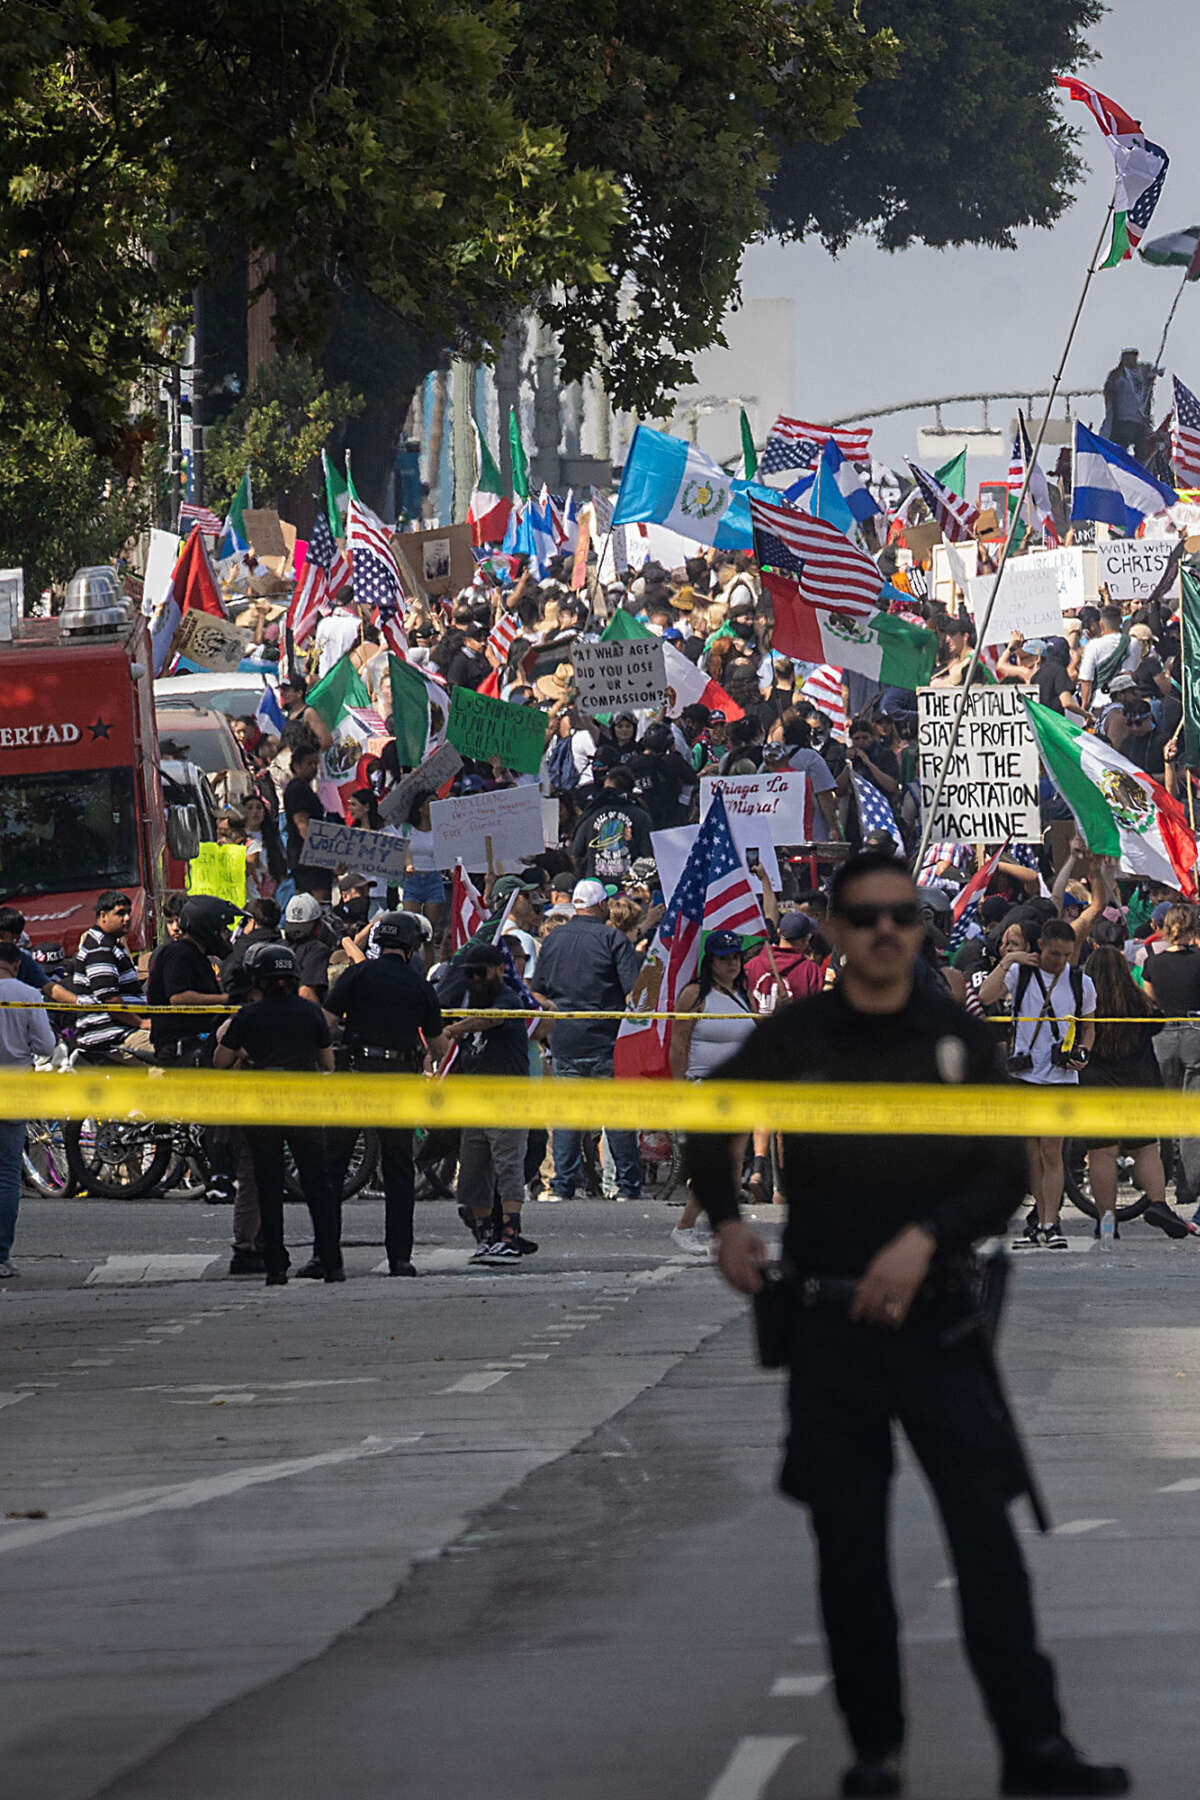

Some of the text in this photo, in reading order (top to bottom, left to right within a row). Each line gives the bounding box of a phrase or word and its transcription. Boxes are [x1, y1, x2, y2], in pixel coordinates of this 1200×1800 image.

[1144, 542, 1173, 554] with
[595, 645, 625, 659] WHAT
[630, 644, 650, 656] AGE
[577, 661, 654, 678] DID YOU LOSE
[607, 680, 622, 690] UR
[581, 689, 664, 707] COMPASSION?
[919, 692, 950, 717] THE
[977, 752, 1021, 778] THE
[766, 775, 790, 793] La
[921, 782, 1039, 808] DEPORTATION
[725, 798, 781, 816] Migra!
[929, 812, 1028, 839] MACHINE
[310, 821, 406, 852] I AM THE
[309, 836, 356, 856] VOICE
[358, 845, 392, 864] MY
